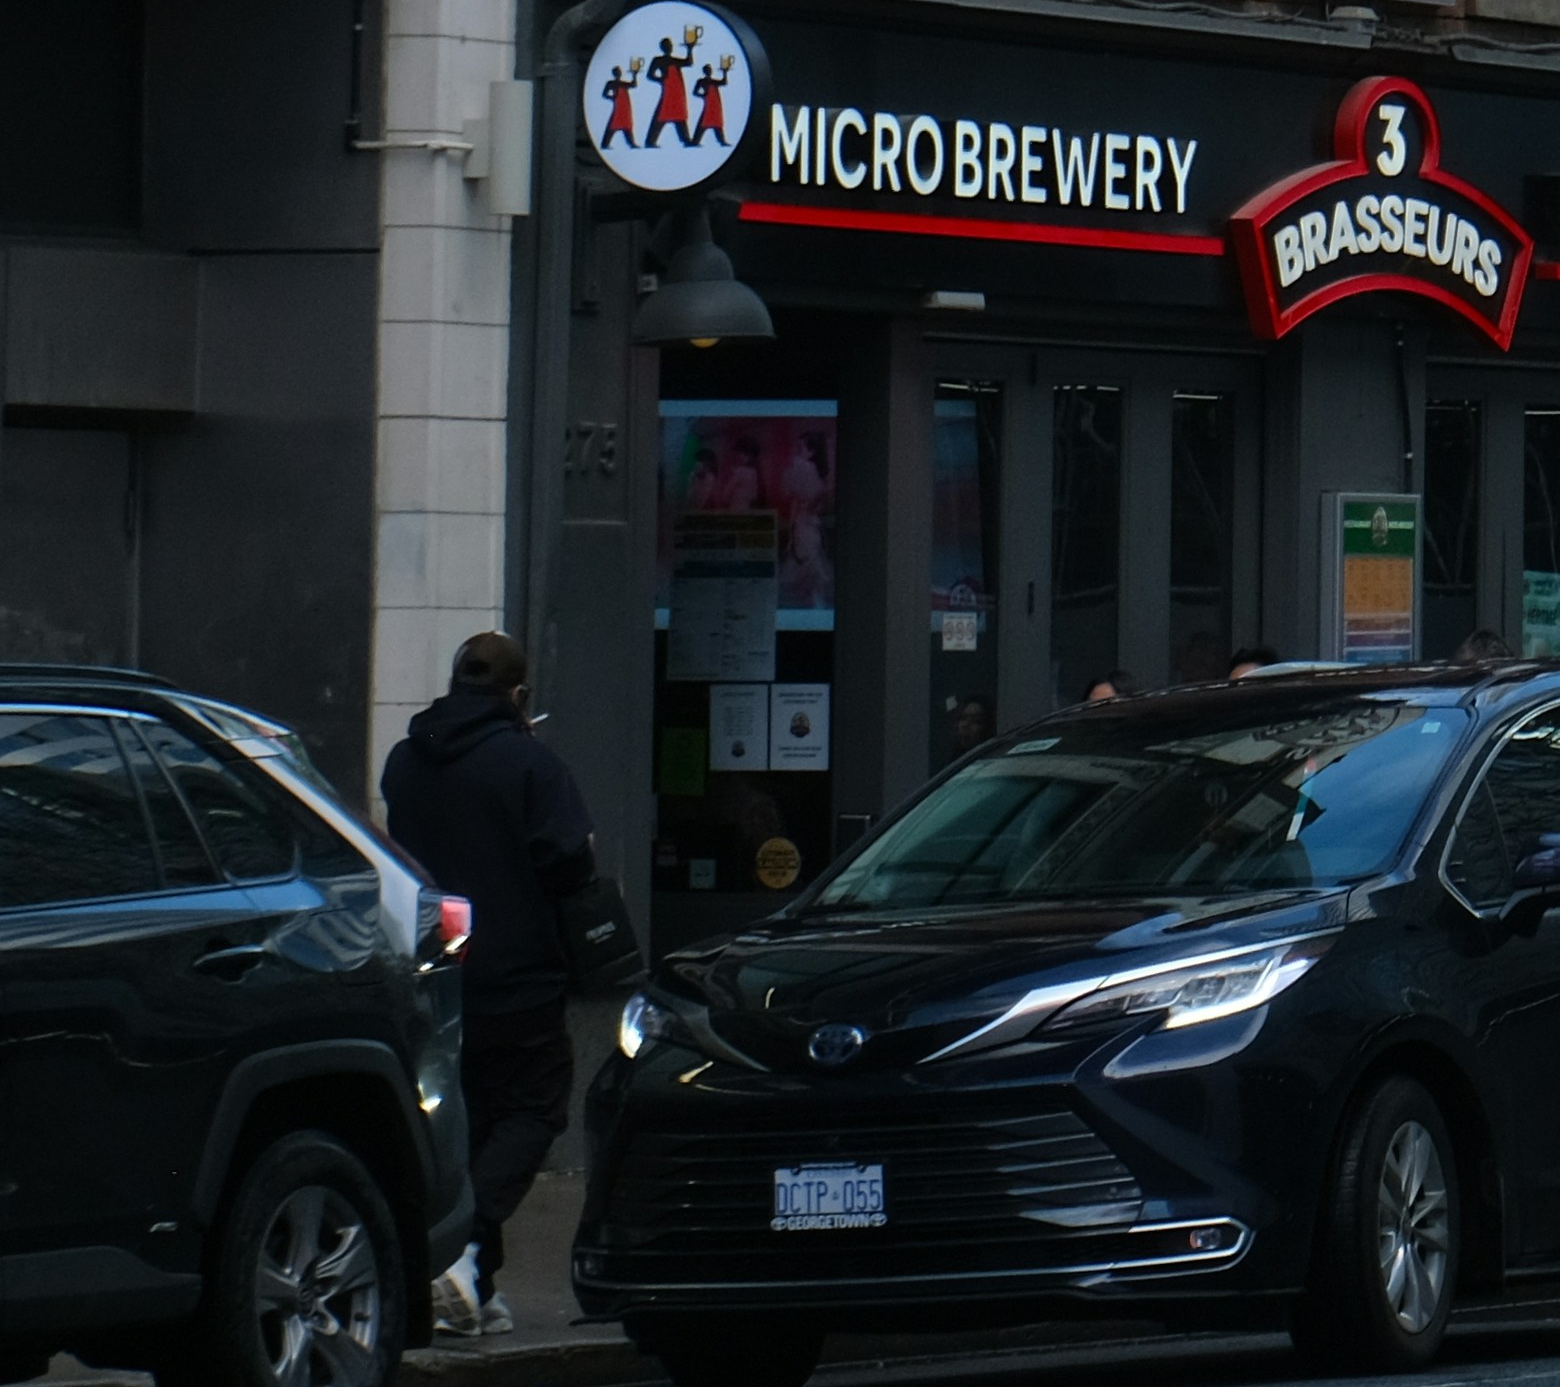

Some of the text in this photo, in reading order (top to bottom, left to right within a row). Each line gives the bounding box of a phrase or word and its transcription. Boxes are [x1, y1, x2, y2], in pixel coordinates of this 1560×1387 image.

[1376, 104, 1407, 177] 3
[1273, 194, 1503, 297] BRASSEURS
[776, 1178, 881, 1215] DCTP 055
[786, 1212, 871, 1232] GEORGETOWN
